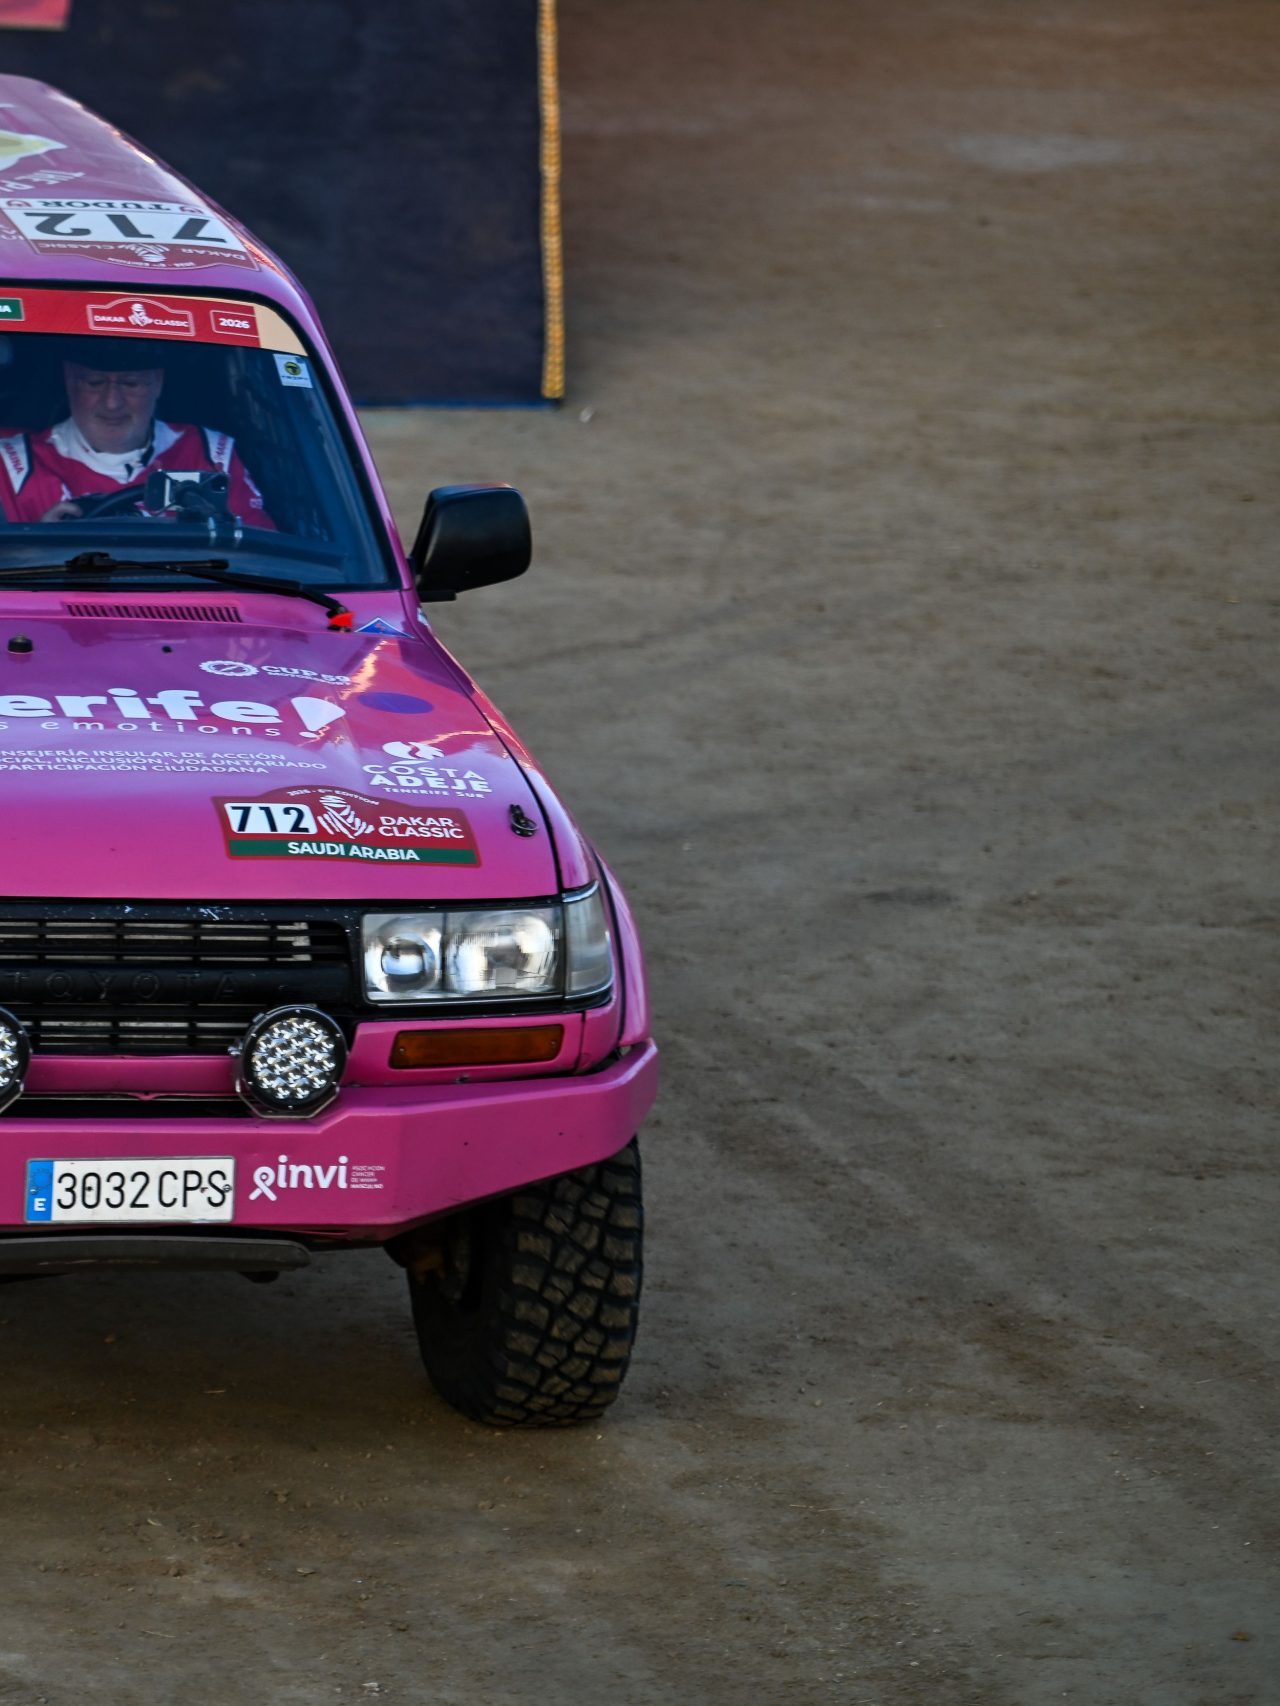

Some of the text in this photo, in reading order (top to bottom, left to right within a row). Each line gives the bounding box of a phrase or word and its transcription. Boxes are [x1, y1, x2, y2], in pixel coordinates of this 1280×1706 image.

[36, 201, 171, 212] TUDOR
[24, 212, 227, 244] 712
[93, 315, 189, 327] DAKAR CLASSIC
[219, 317, 251, 329] 2026
[261, 665, 318, 677] CUP
[41, 721, 280, 737] emotions
[93, 750, 177, 759] INSULAR
[214, 752, 286, 760] ACCIÓN
[151, 765, 270, 773] CIUDADANA
[171, 758, 328, 770] VOLUNTARIADO
[362, 764, 487, 780] COSTA
[369, 774, 493, 793] ADEJE
[383, 787, 485, 799] TENERIFE SUR
[231, 805, 310, 833] 712
[379, 815, 454, 828] DAKAR
[378, 826, 464, 839] CLASSIC
[287, 841, 420, 861] SAUDI ARABIA
[4, 970, 241, 999] TOYOTA
[277, 1154, 348, 1189] invi
[57, 1170, 228, 1210] 3032 CPS
[34, 1198, 47, 1212] E
